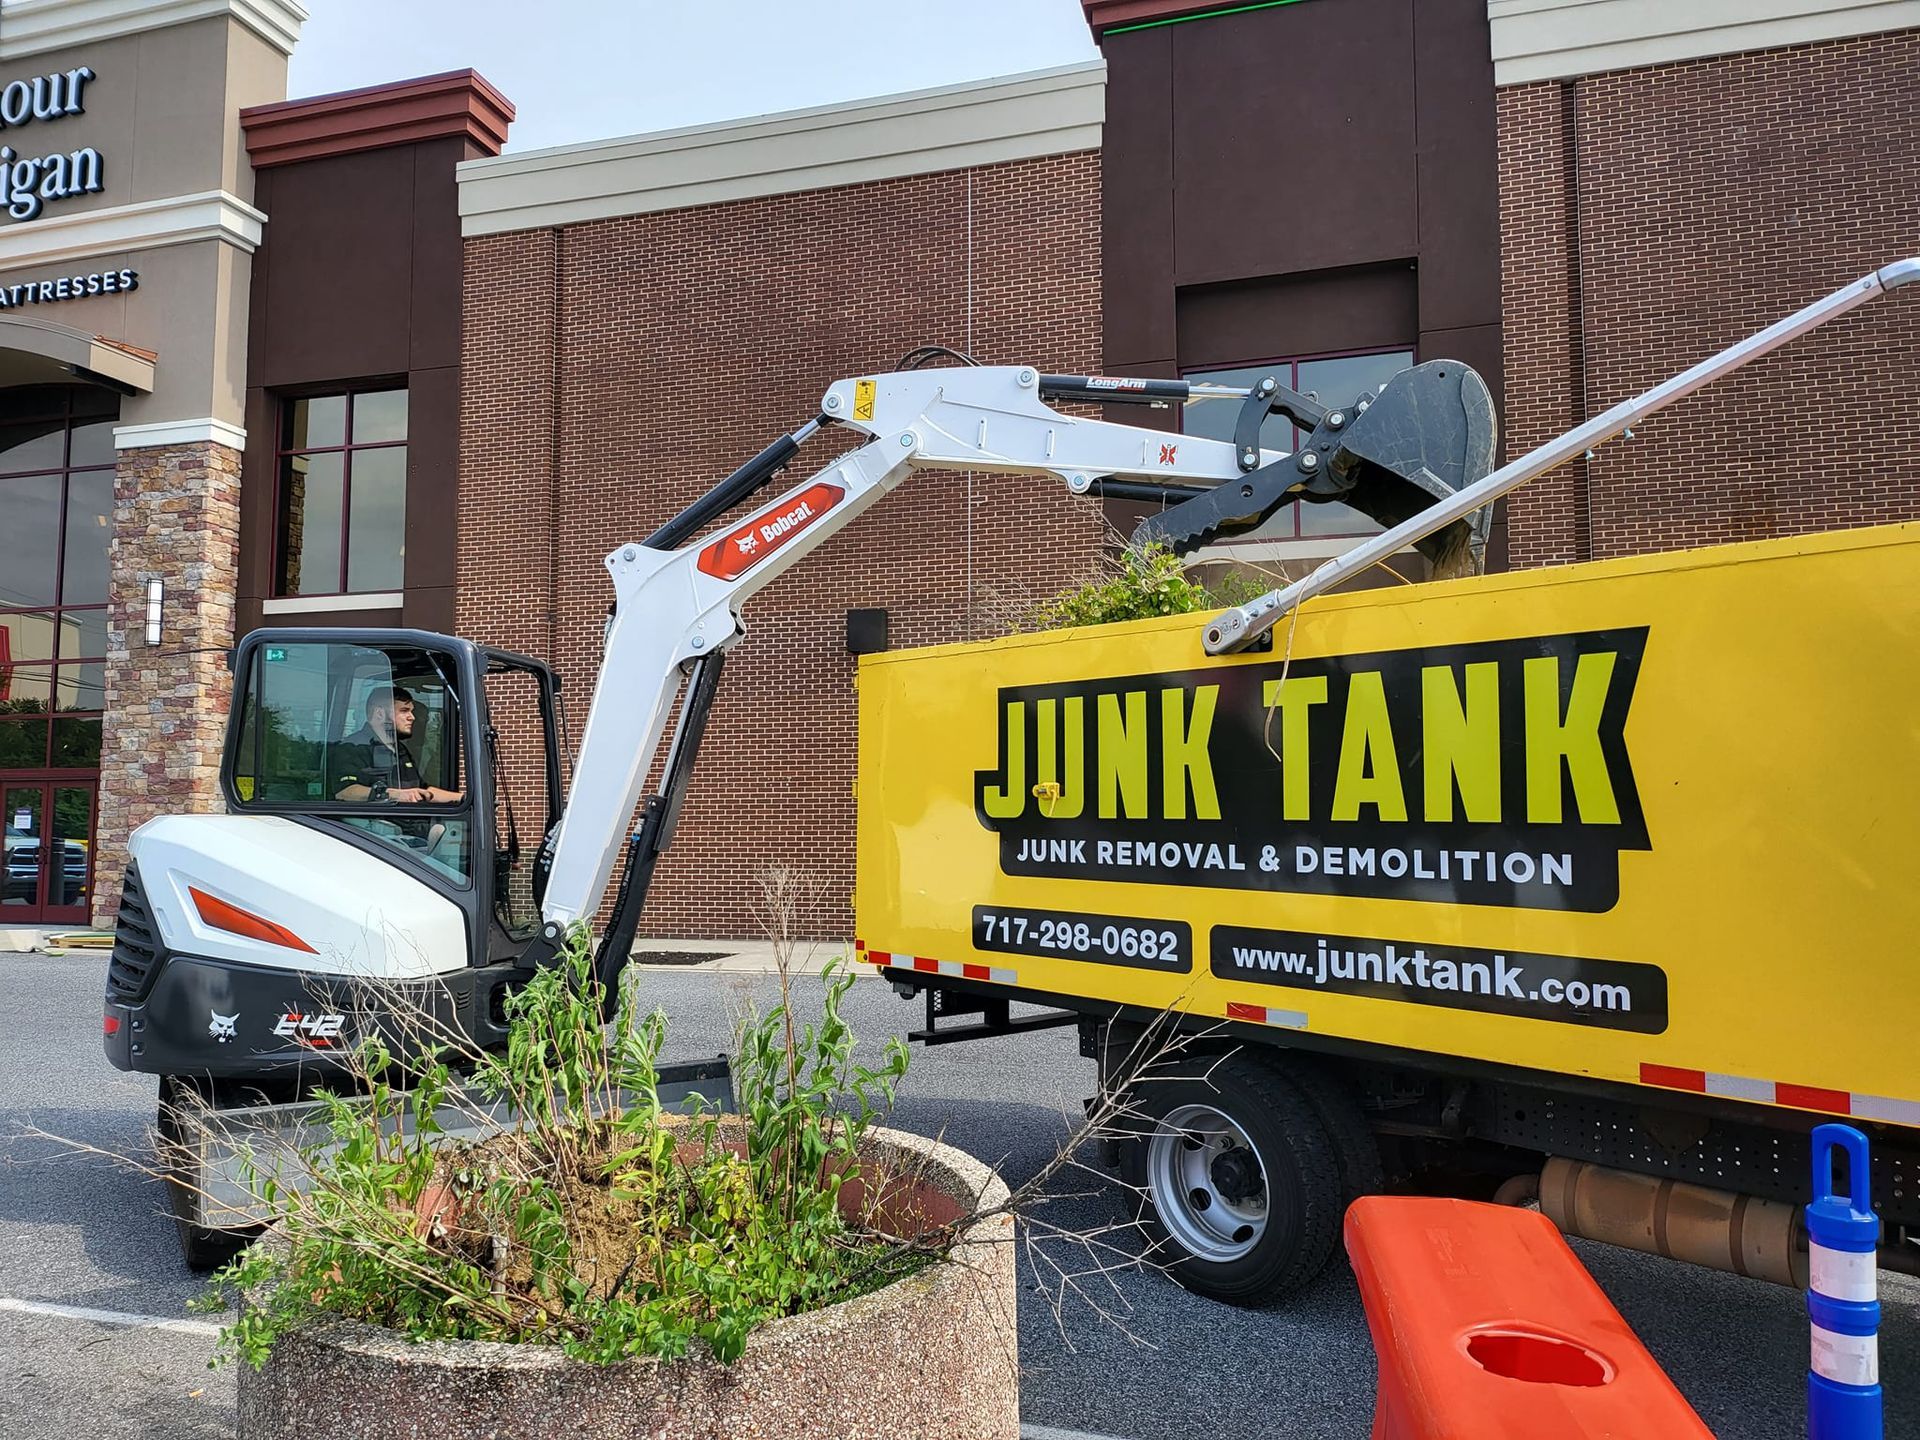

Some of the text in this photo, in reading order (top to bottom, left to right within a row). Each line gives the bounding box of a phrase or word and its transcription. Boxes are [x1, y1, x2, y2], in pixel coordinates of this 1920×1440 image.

[1087, 376, 1147, 390] LongArm
[760, 501, 813, 543] Bobcat
[983, 651, 1622, 824] JUNK TANK
[1017, 839, 1574, 886] JUNK REMOVAL & DEMOLITION
[982, 915, 1179, 962] 717-298-0682
[1232, 939, 1632, 1012] www.junktank.com
[273, 1013, 346, 1036] E42
